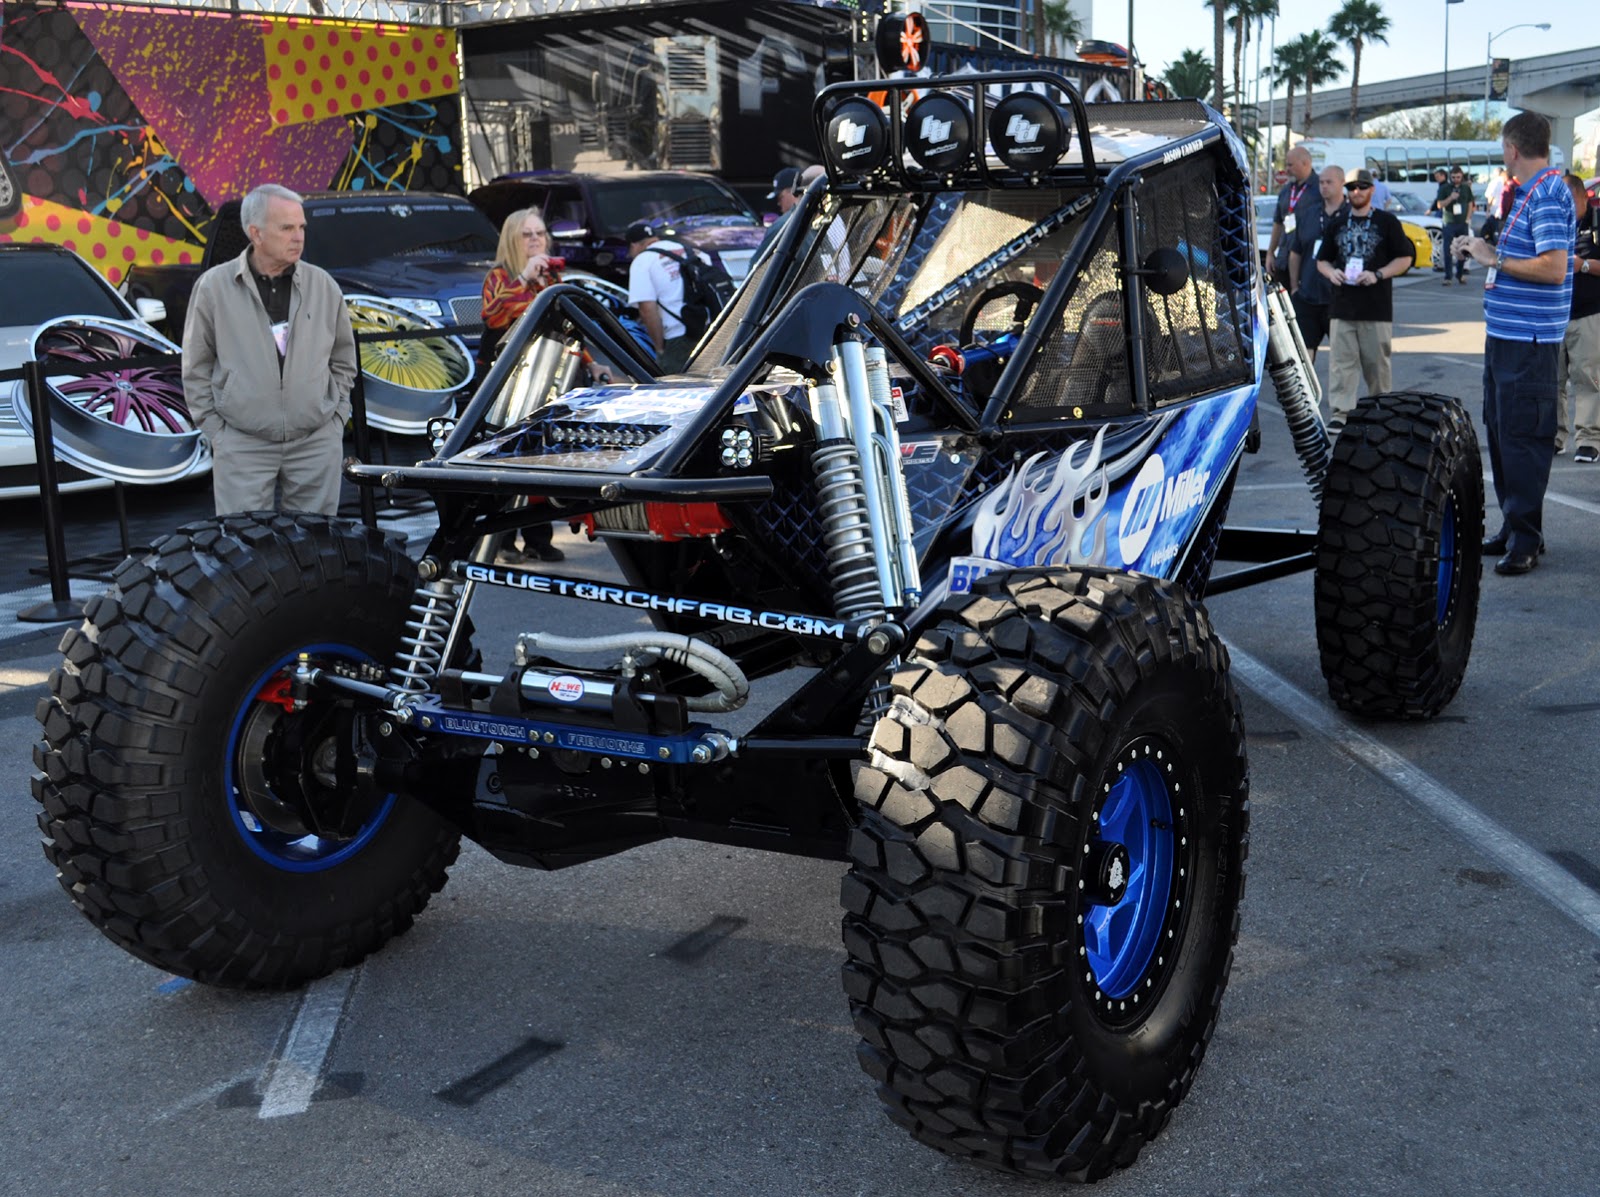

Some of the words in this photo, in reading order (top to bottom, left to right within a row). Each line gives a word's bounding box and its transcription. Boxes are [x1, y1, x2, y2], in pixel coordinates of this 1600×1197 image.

[1159, 467, 1211, 522] Miller
[465, 565, 845, 640] BLUETORCHFAB.COM
[445, 717, 526, 738] BLUETORCH
